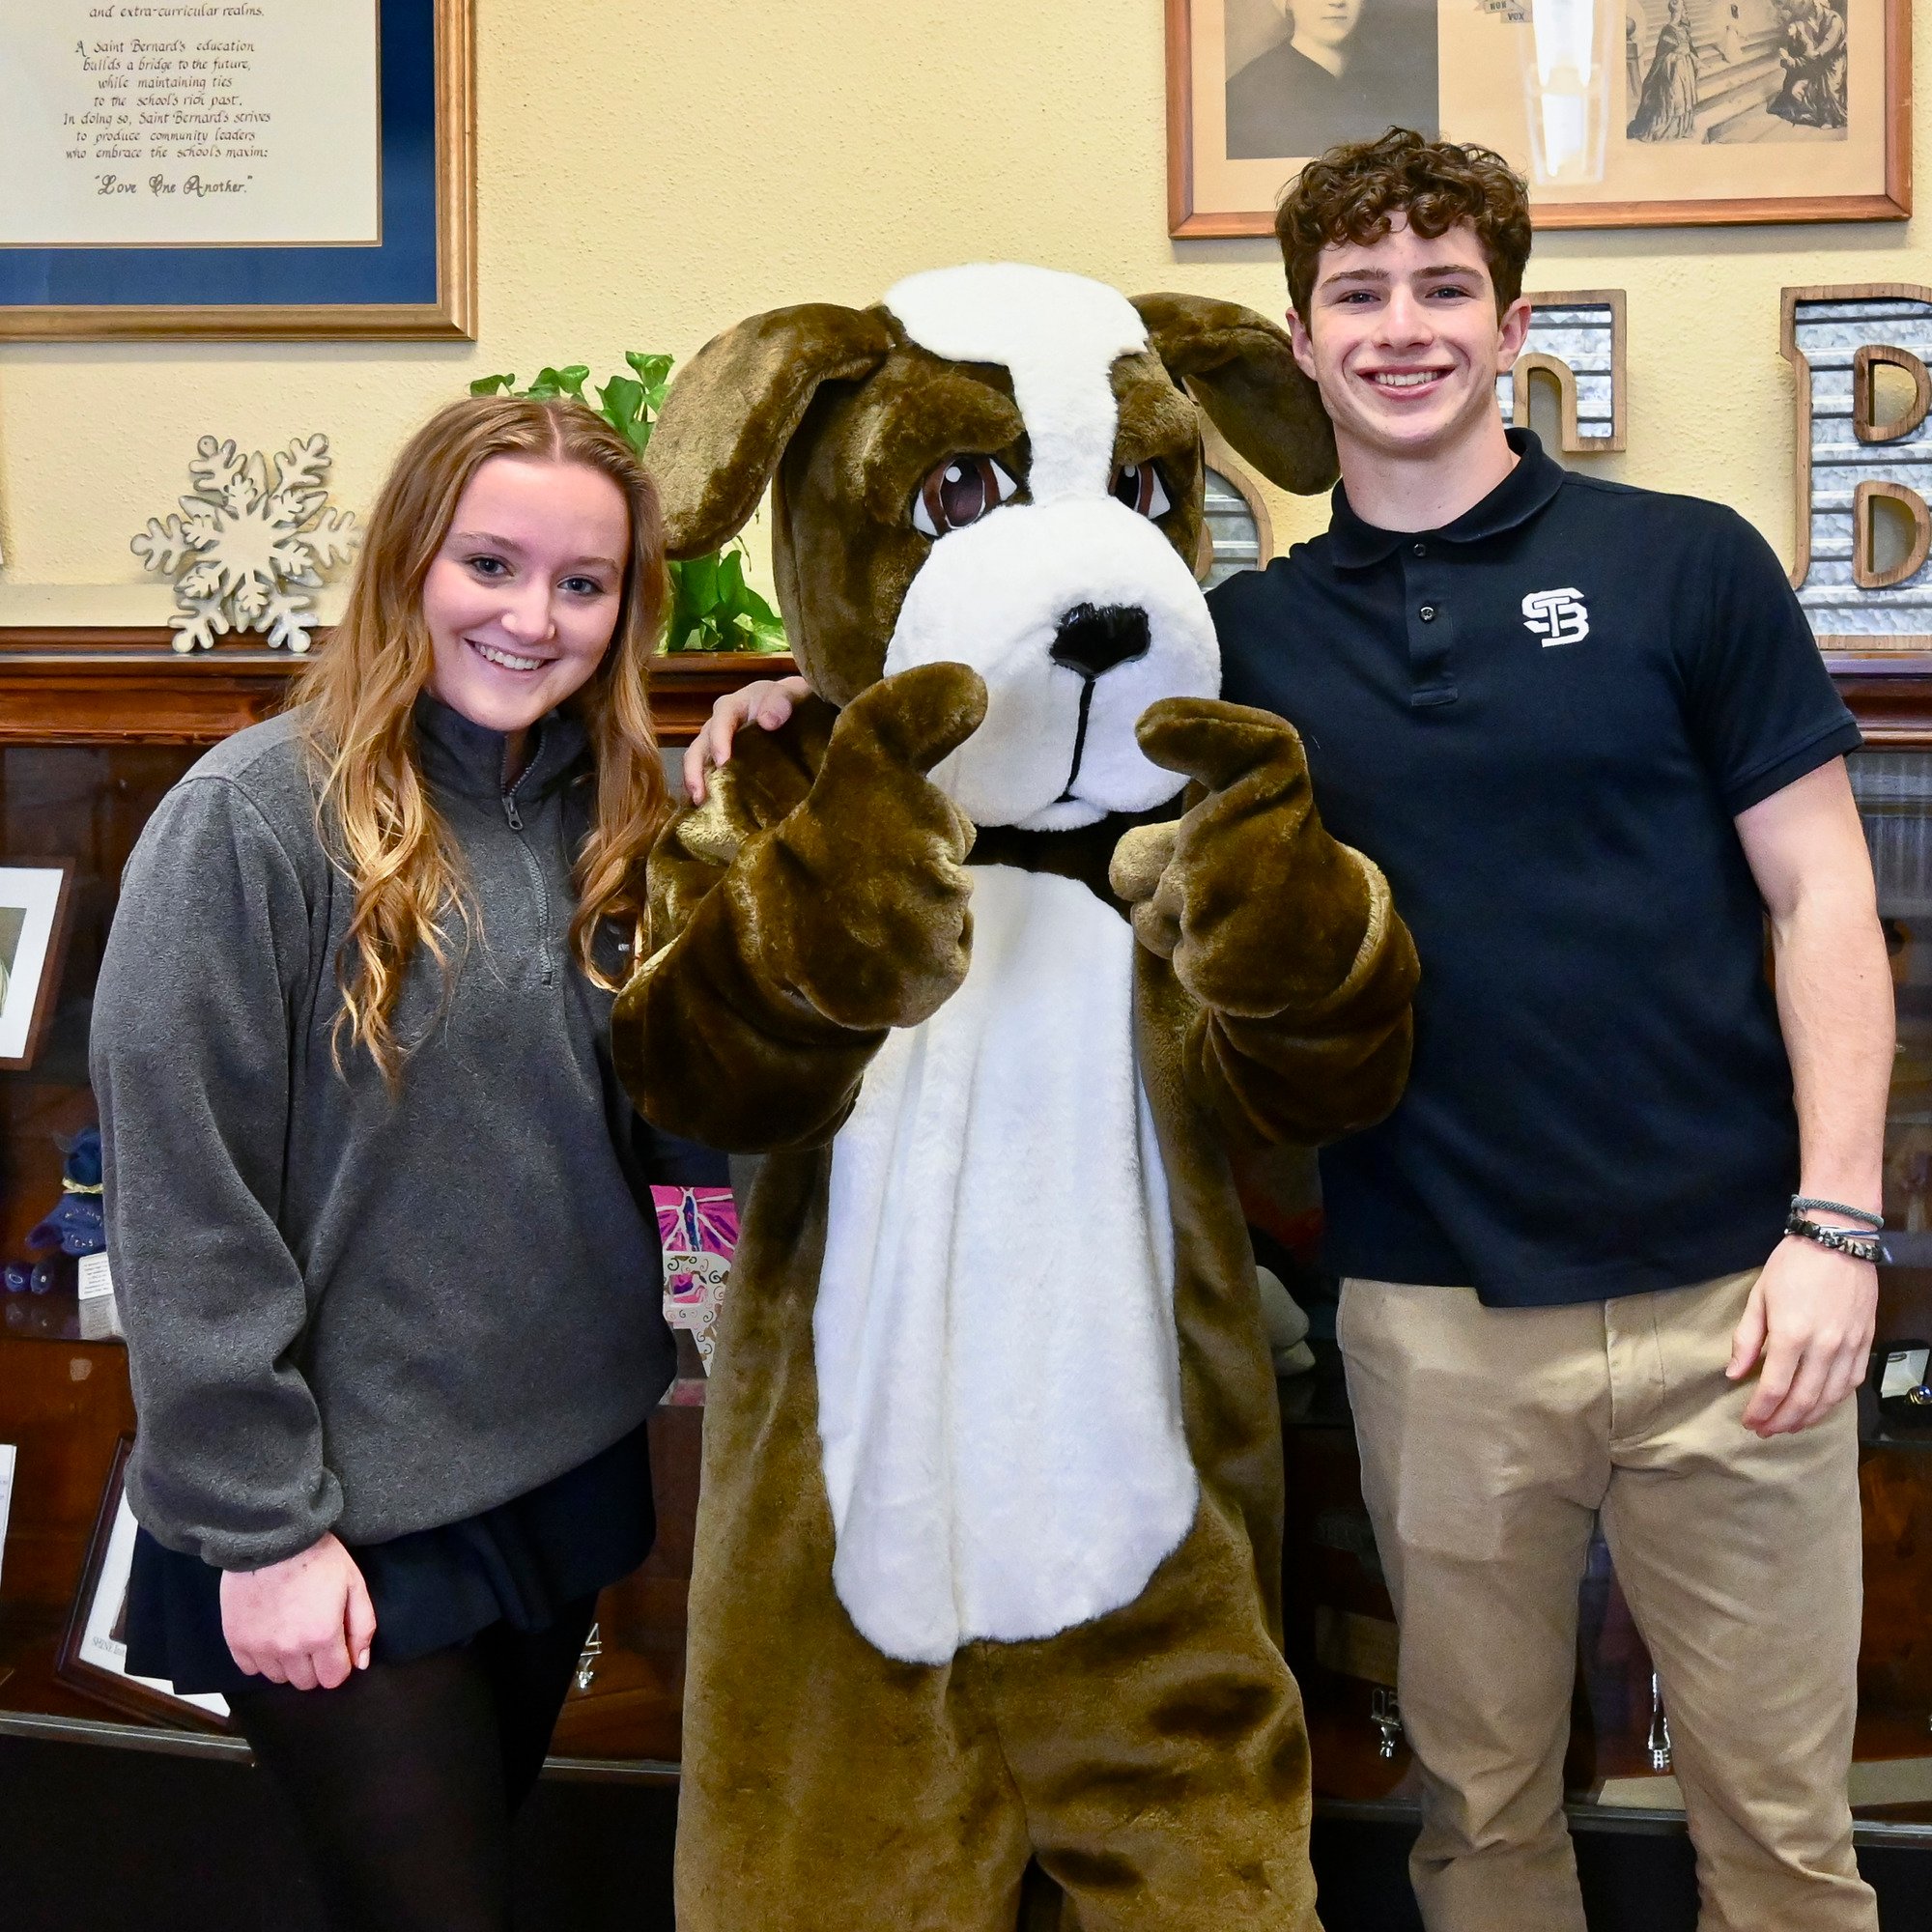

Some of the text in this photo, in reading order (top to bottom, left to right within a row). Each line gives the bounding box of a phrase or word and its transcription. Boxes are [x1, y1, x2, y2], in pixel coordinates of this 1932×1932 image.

[90, 3, 265, 17] and extra-curricular realms.
[1507, 12, 1524, 21] VOX
[94, 40, 125, 53] Saint
[130, 39, 185, 53] Bernard's
[196, 39, 255, 52] education
[83, 56, 251, 74] builds a bridge to the future,
[99, 73, 233, 91] while maintaining ties
[94, 92, 242, 111] to the school's rich past.
[64, 110, 271, 128] In doing so, Saint Bernard's strives
[76, 127, 256, 146] to produce community leaders
[66, 144, 269, 159] who embrace the school's maxim:
